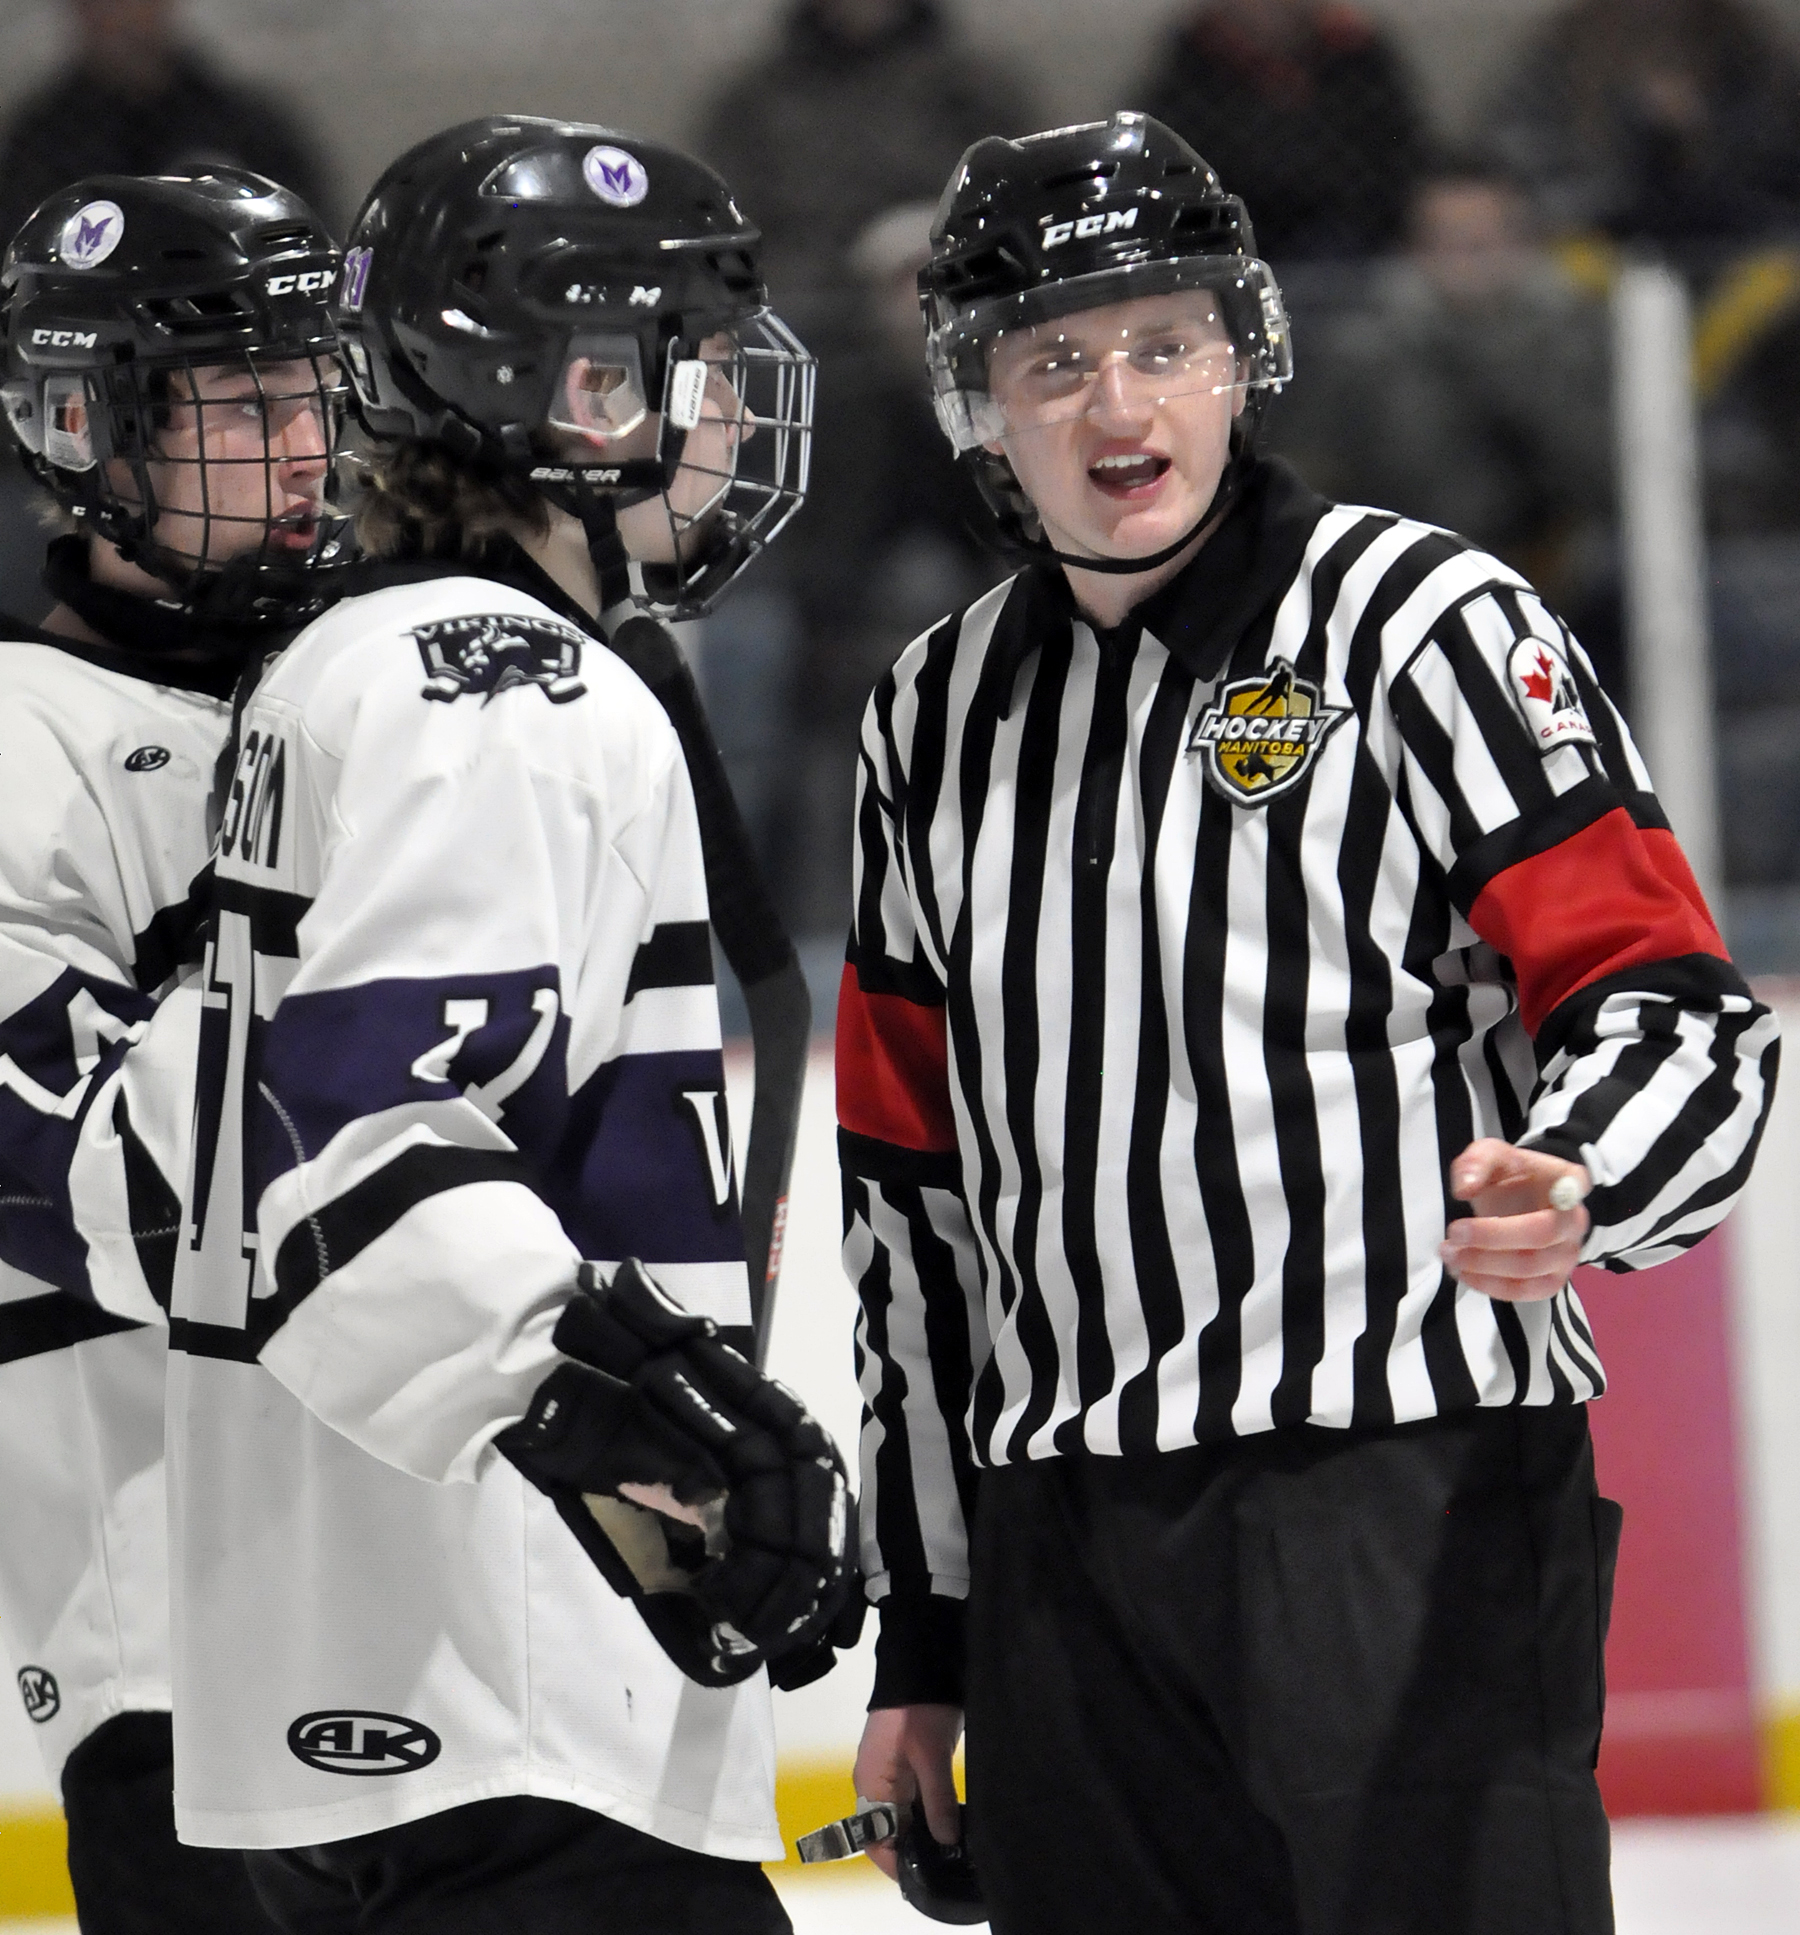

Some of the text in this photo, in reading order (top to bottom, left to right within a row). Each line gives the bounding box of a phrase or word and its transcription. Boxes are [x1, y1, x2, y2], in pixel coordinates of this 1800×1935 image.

[1041, 207, 1139, 251] CCM
[267, 270, 338, 296] CCM
[32, 328, 98, 349] CCM
[530, 466, 621, 484] BAER
[411, 613, 587, 645] VIKINGS
[1202, 716, 1326, 742] HOCKEY
[1218, 740, 1305, 756] MANITOBA
[293, 1713, 438, 1769] AK
